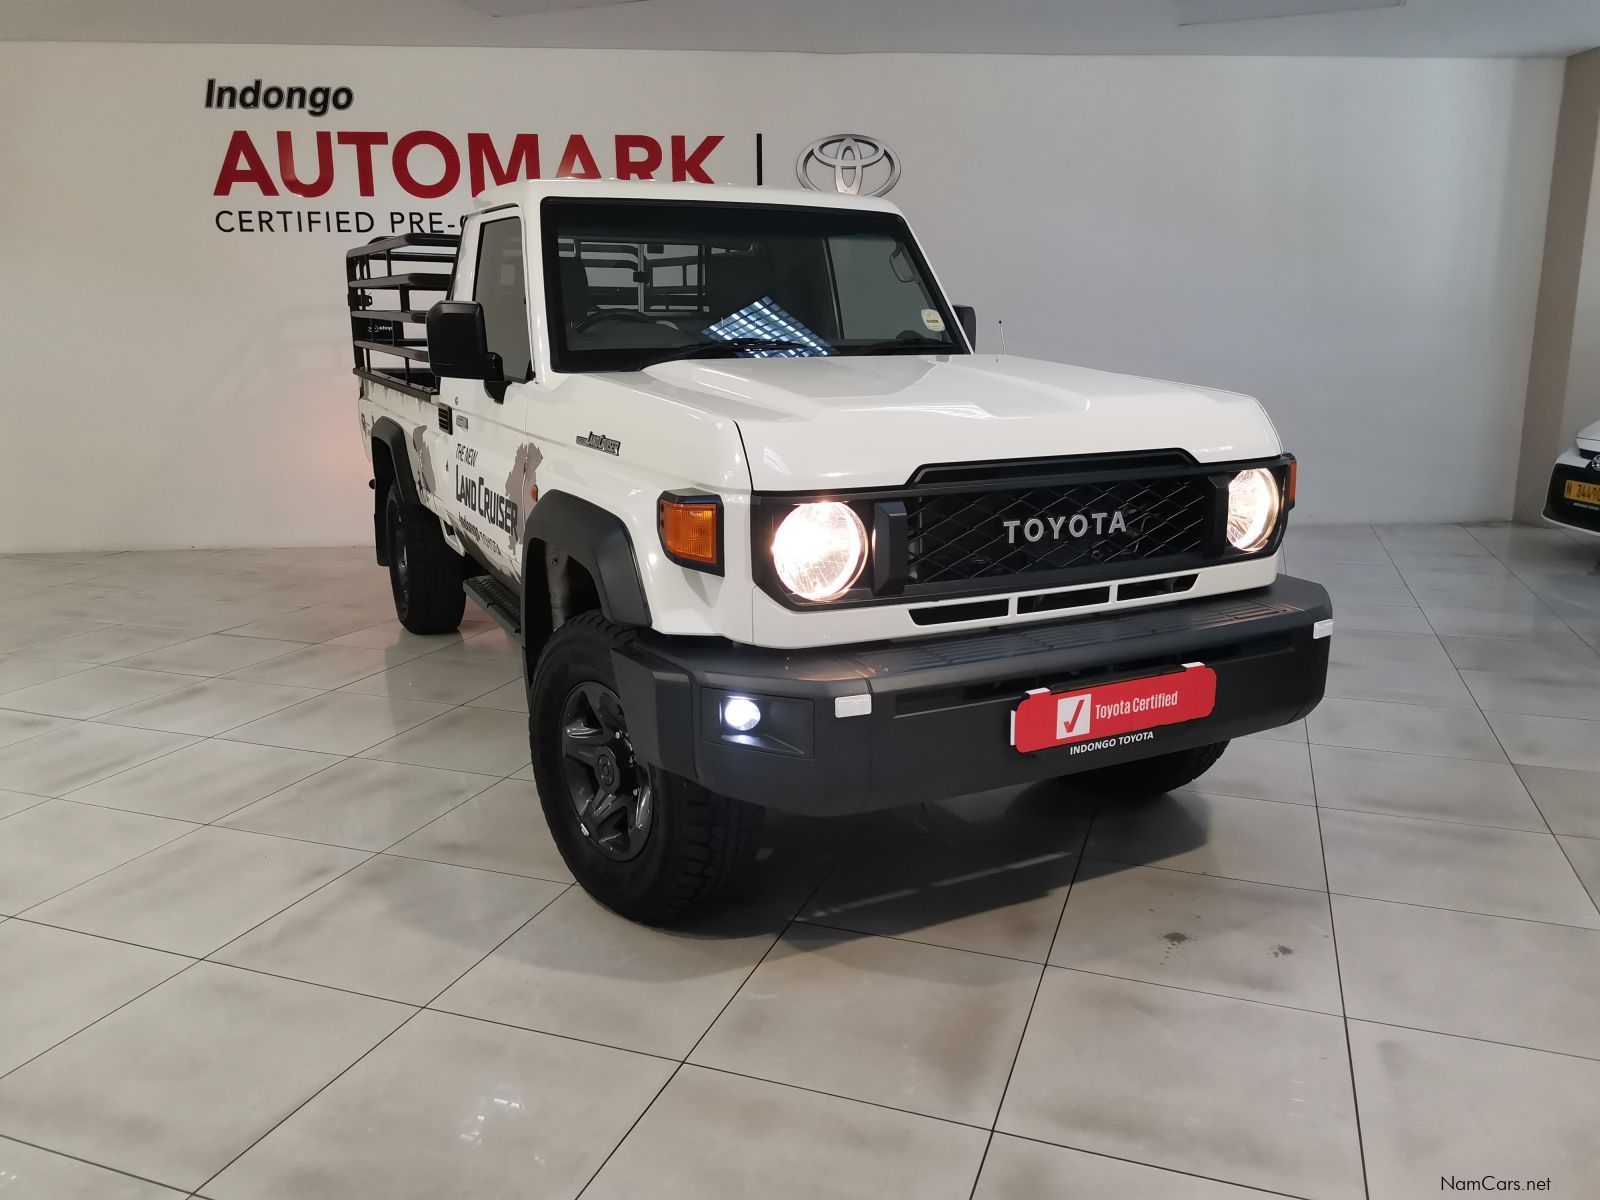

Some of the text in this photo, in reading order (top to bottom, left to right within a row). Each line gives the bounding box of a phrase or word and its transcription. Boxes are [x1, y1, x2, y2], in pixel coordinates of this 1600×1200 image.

[205, 78, 354, 117] Indongo
[213, 130, 725, 199] AUTOMARK
[215, 210, 467, 233] CERTIFIED PRE-
[455, 443, 479, 467] THE NEW
[456, 464, 519, 542] LAND CRUISER
[1003, 510, 1127, 544] TOYOTA
[1095, 691, 1178, 720] Toyota Certified
[1069, 731, 1154, 756] INDONGO TOYOTA
